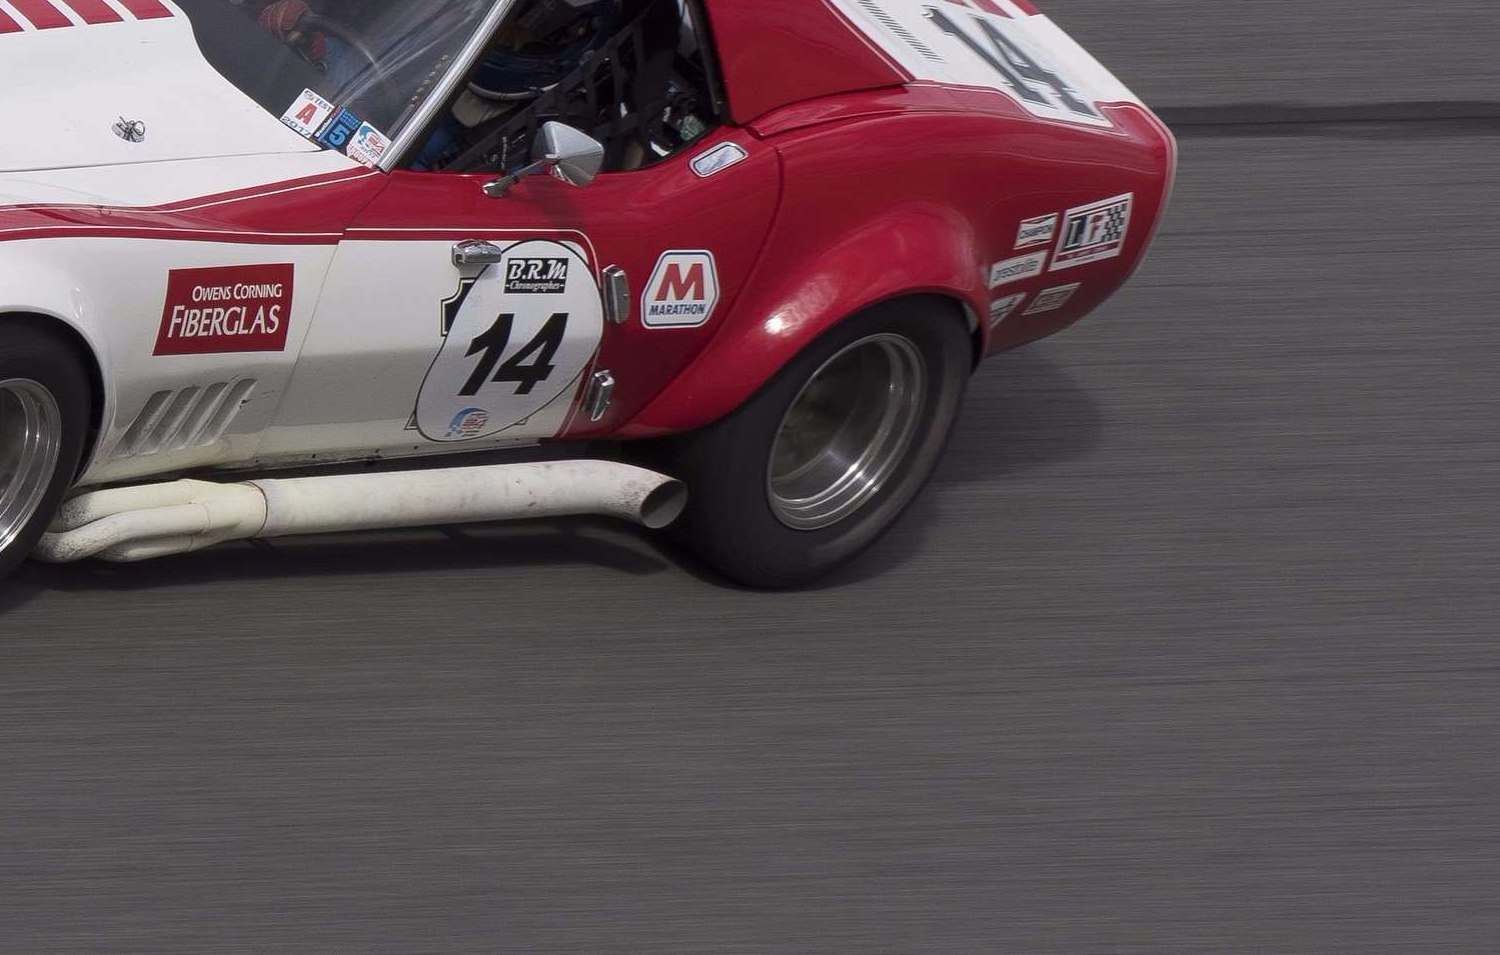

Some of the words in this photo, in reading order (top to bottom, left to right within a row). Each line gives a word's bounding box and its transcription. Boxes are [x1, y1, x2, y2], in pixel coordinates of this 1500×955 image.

[921, 3, 1106, 122] 14
[295, 102, 317, 126] A
[328, 126, 350, 147] 5
[192, 285, 232, 302] OWENS
[233, 282, 283, 300] CORNING
[654, 263, 705, 301] M
[167, 304, 281, 338] FIBERGLAS
[648, 304, 707, 316] MARATHON
[457, 312, 569, 396] 14
